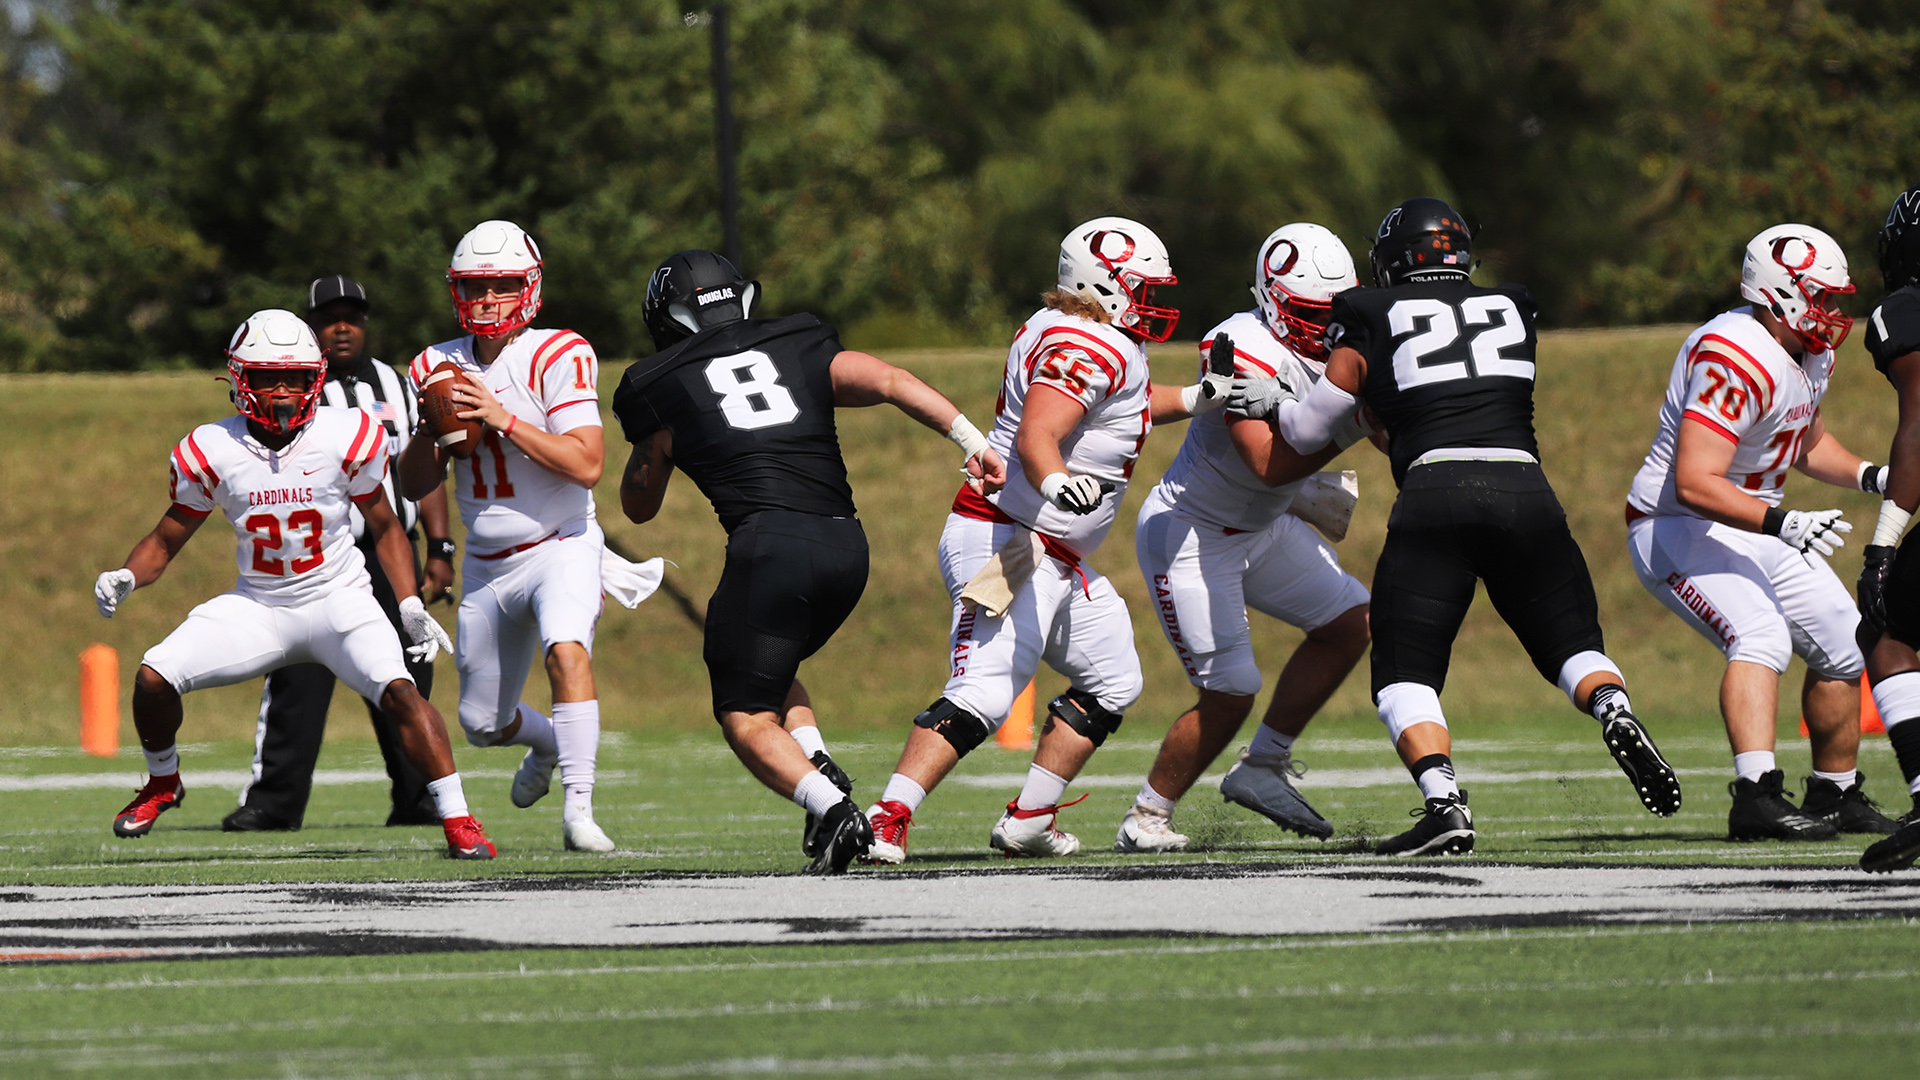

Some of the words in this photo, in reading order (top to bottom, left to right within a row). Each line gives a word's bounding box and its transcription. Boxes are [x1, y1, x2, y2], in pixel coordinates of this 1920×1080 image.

[572, 354, 596, 391] 11
[1037, 350, 1094, 397] 55
[1387, 294, 1536, 391] 22
[702, 347, 802, 432] 8
[1698, 365, 1747, 421] 70
[249, 487, 313, 507] CARDINALS
[469, 430, 516, 500] 11
[245, 508, 325, 577] 23
[1153, 574, 1199, 677] CARDINALS
[1665, 571, 1736, 650] CARDINALS
